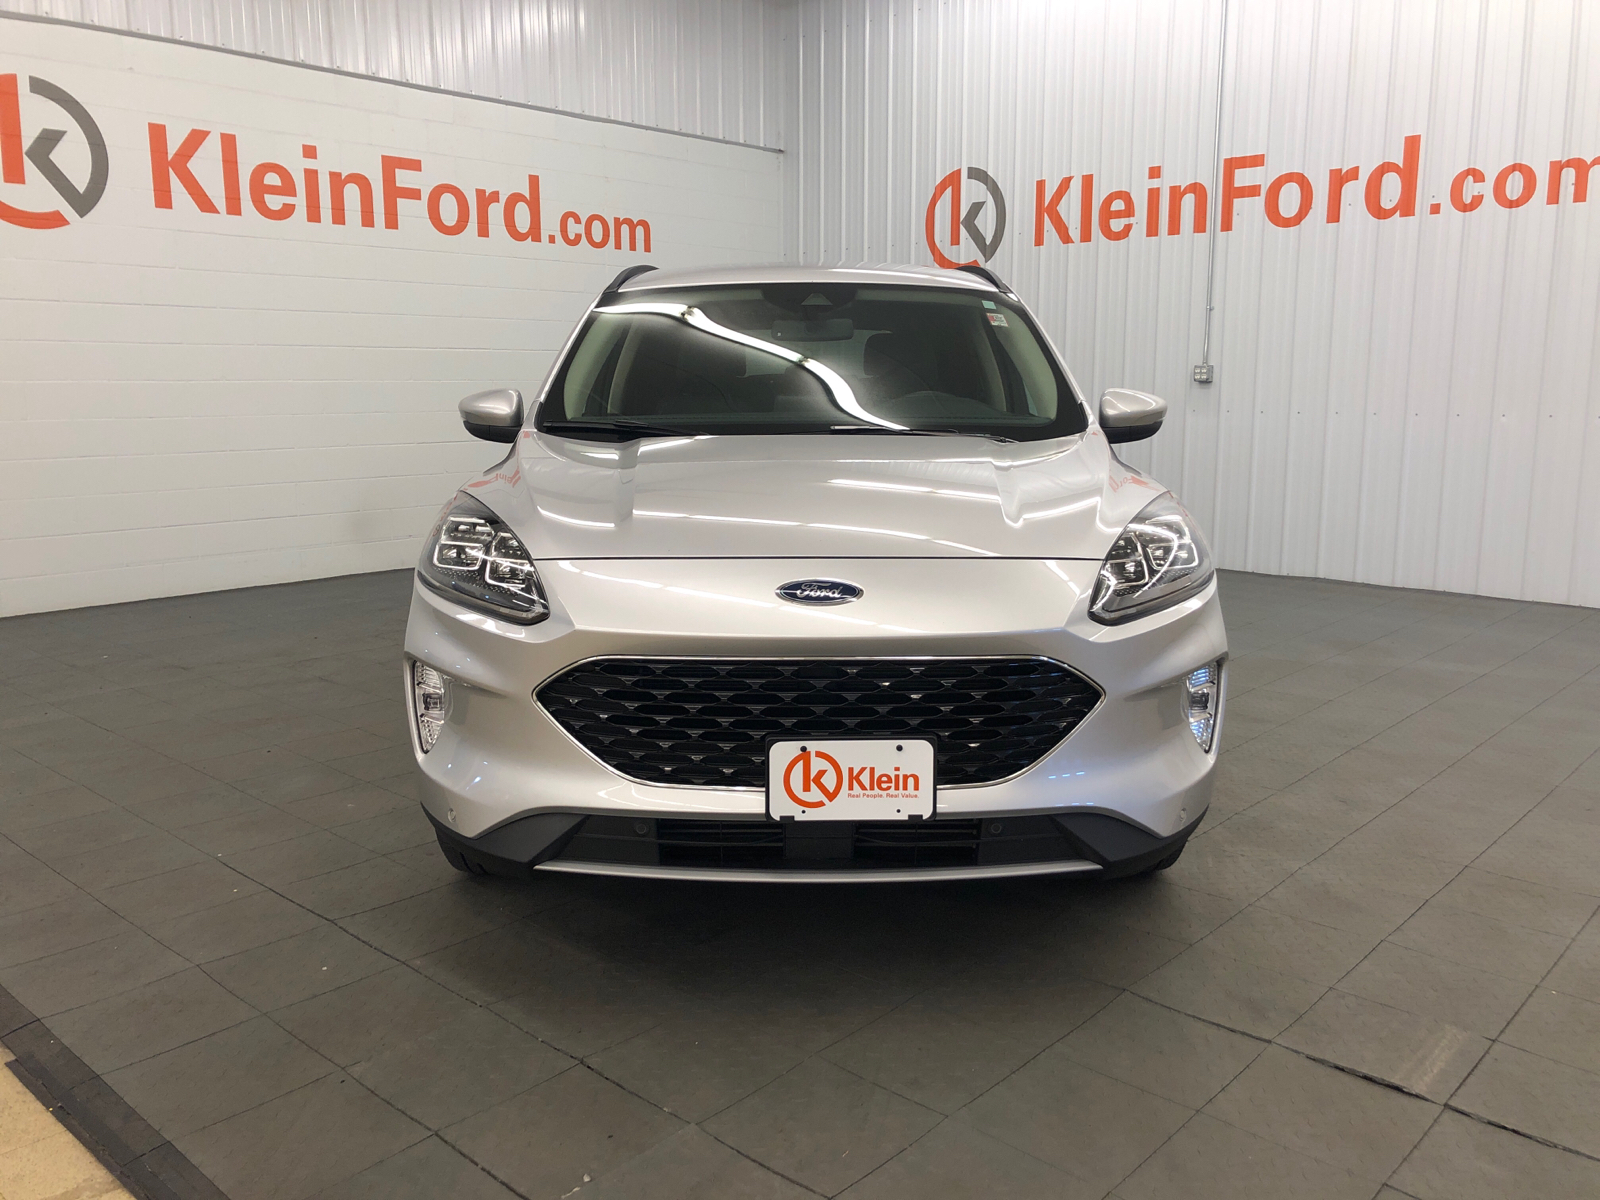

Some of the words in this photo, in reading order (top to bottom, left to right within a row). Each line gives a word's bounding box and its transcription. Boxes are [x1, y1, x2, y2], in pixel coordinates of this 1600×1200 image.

[147, 121, 652, 253] KleinFord.com
[1034, 134, 1600, 247] KleinFord.com
[797, 582, 846, 598] Ford
[847, 766, 920, 792] Klein
